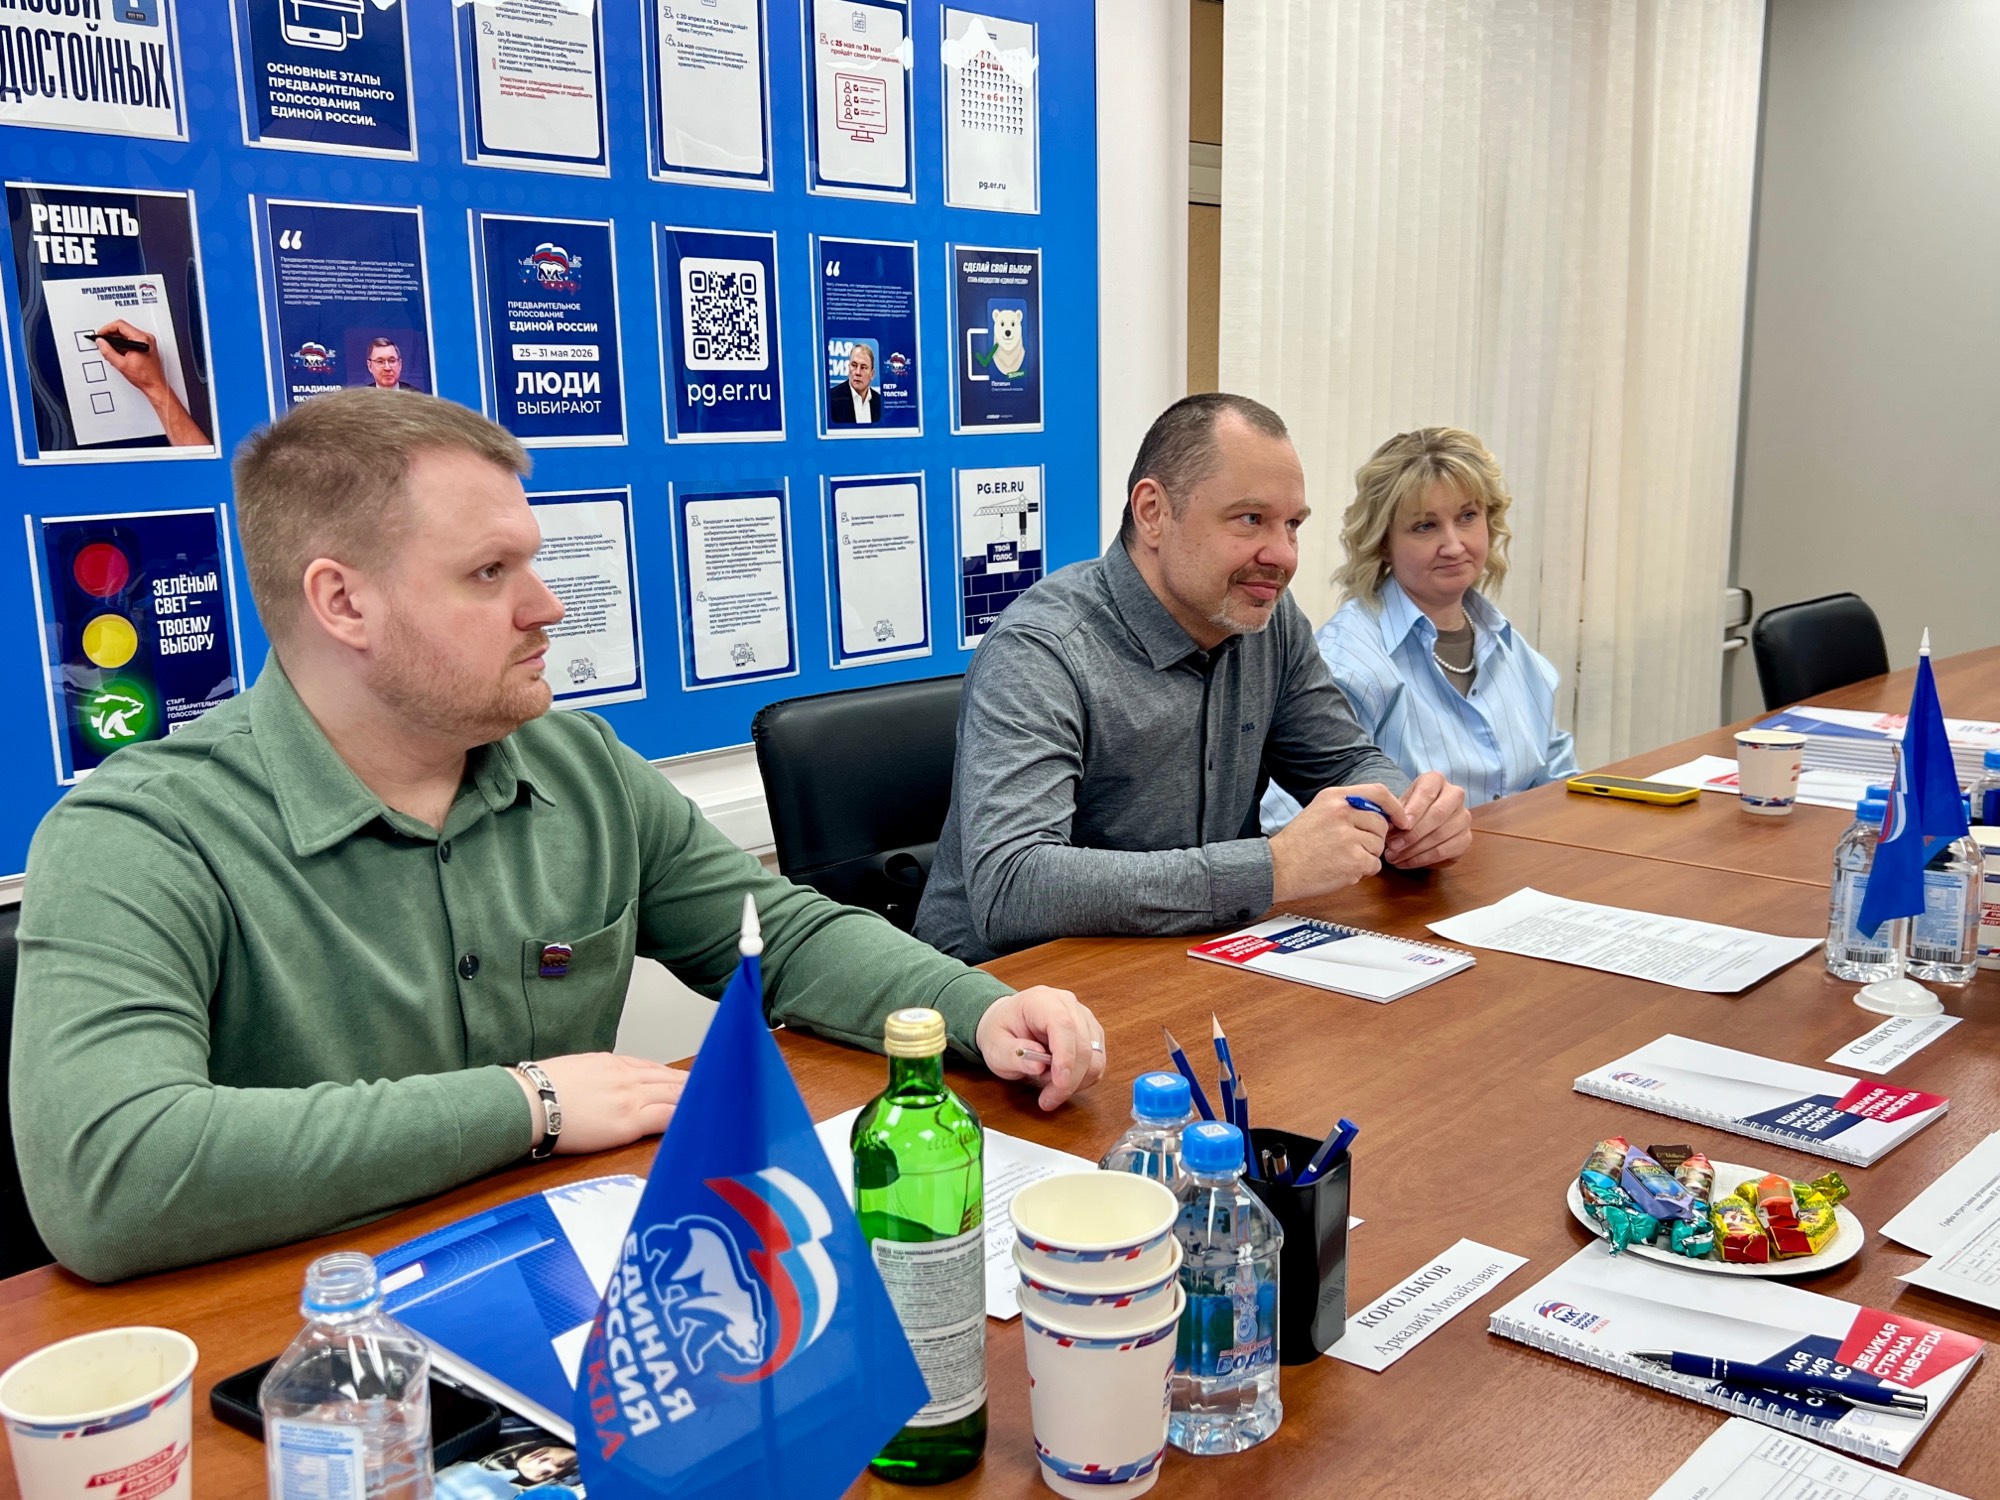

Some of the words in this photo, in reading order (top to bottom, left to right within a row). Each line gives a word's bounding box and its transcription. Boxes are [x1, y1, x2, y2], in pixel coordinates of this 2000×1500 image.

[863, 43, 868, 51] 31
[0, 23, 171, 109] ДОСТОЙНЫХ
[267, 62, 338, 80] ОСНОВНЫЕ
[339, 71, 381, 86] ЭТАПЫ
[268, 76, 395, 101] ПРЕДВАРИТЕЛЬНОГО
[269, 91, 361, 111] ГОЛОСОВАНИЯ
[271, 105, 323, 121] ЕДИНОЙ
[325, 111, 377, 127] РОССИИ.
[978, 180, 1006, 190] pg.er.ru
[31, 203, 139, 236] РЕШАТЬ
[33, 234, 98, 265] ТЕБЕ
[962, 261, 990, 273] СДЕЛАЙ
[990, 262, 1008, 273] СВОЙ
[1009, 264, 1032, 274] ВЫБОР
[81, 284, 136, 295] ПРЕДВАРИТЕЛЬНОЕ
[508, 301, 581, 310] ПРЕДВАРИТЕЛЬНОЕ
[508, 310, 564, 318] ГОЛОСОВАНИЕ
[509, 320, 554, 332] ЕДИНОЙ
[556, 322, 598, 332] РОССИИ
[520, 348, 530, 357] 25
[538, 349, 547, 357] 31
[571, 349, 593, 358] 2026
[292, 385, 342, 394] ВЛАДИМИР
[516, 372, 600, 398] ЛЮДИ
[687, 384, 771, 407] pg.er.ru
[517, 400, 602, 414] ВЫБИРАЮТ
[977, 481, 1024, 494] PG.ER.RU
[993, 553, 1012, 561] ГОЛОС
[994, 543, 1010, 552] ТВОЙ
[152, 572, 218, 596] ЗЕЛЁНЫЙ
[154, 596, 188, 615] СВЕТ
[157, 615, 211, 636] ТВОЕМУ
[159, 633, 214, 655] ВЫБОРУ
[166, 698, 185, 706] СТАРТ
[1845, 1088, 1888, 1114] ВЕЛИКАЯ
[1861, 1094, 1897, 1117] СТРАНА
[1875, 1092, 1921, 1121] НАВСЕГДА
[1775, 1102, 1818, 1125] ЕДИНАЯ
[1790, 1105, 1833, 1129] РОССИЯ
[1806, 1111, 1846, 1132] СЕЙЧАС
[1357, 1265, 1452, 1329] КОРОЛЬКОВ
[1374, 1314, 1434, 1356] Аркадий
[1424, 1263, 1504, 1316] Михайлович
[622, 1231, 697, 1423] ЕДИНАЯ
[1852, 1322, 1900, 1371] ВЕЛИКАЯ
[1873, 1335, 1916, 1376] СТРАНА
[1893, 1330, 1945, 1382] НАВСЕГДА
[1216, 1344, 1272, 1376] ВОДА
[96, 1450, 172, 1484] ГОРДОСТЬ
